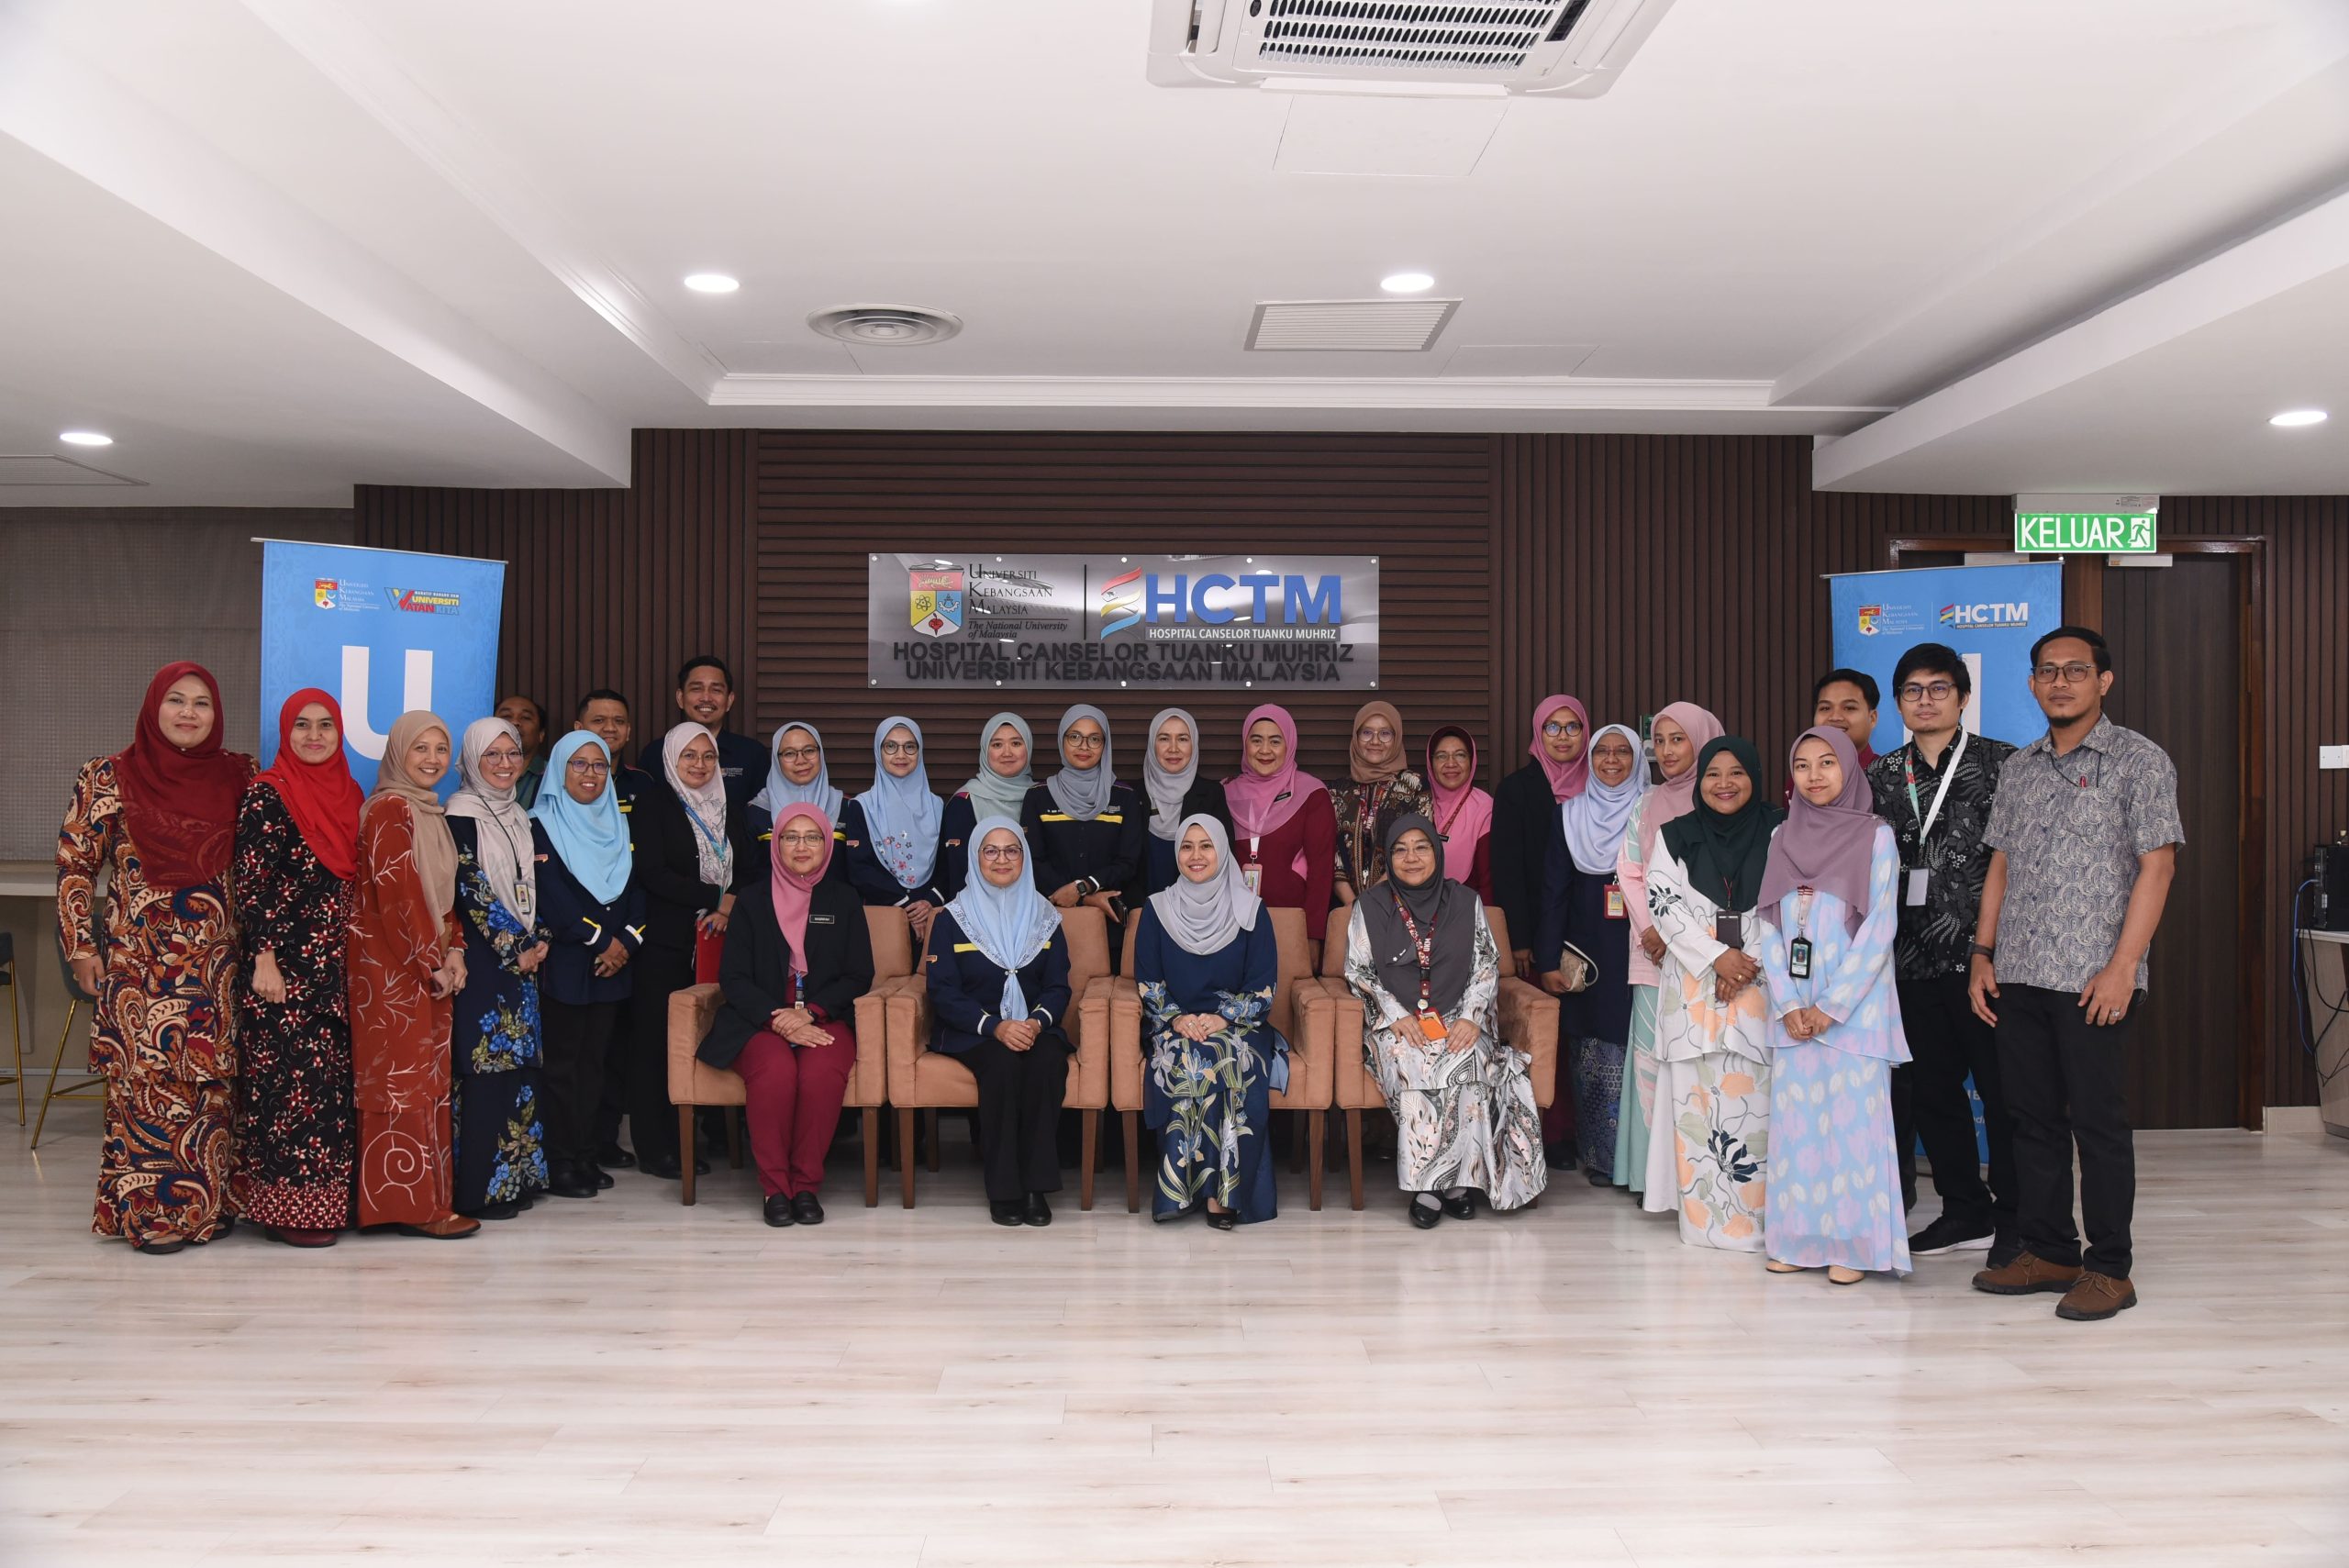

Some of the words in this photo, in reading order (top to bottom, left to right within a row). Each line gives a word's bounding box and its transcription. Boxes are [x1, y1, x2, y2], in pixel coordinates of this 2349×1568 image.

[2021, 517, 2125, 549] KELUAR
[969, 581, 1053, 597] KEBANGSAAN
[412, 595, 460, 606] UNIVERSITI
[969, 598, 1029, 615] MALAYSIA
[1145, 573, 1342, 625] HCTM
[1954, 602, 2029, 624] HCTM
[968, 621, 985, 630] The
[987, 621, 1022, 630] National
[1025, 621, 1068, 632] University
[968, 630, 978, 639] of
[979, 629, 1018, 639] Malaysia
[1149, 628, 1197, 639] HOSPITAL
[1198, 628, 1251, 639] CANSELOR
[1252, 628, 1293, 639] TUANKU
[1295, 628, 1337, 639] MUHRIZ
[893, 641, 1011, 662] HOSPITAL
[1017, 642, 1150, 662] CANSELOR
[1155, 643, 1255, 662] TUANKU
[1263, 643, 1354, 662] MUHRIZ
[905, 661, 1037, 681] UNIVERSITI
[1044, 662, 1212, 682] KEBANGSAAN
[1220, 662, 1341, 682] MALAYSIA
[1423, 938, 1432, 952] UKM
